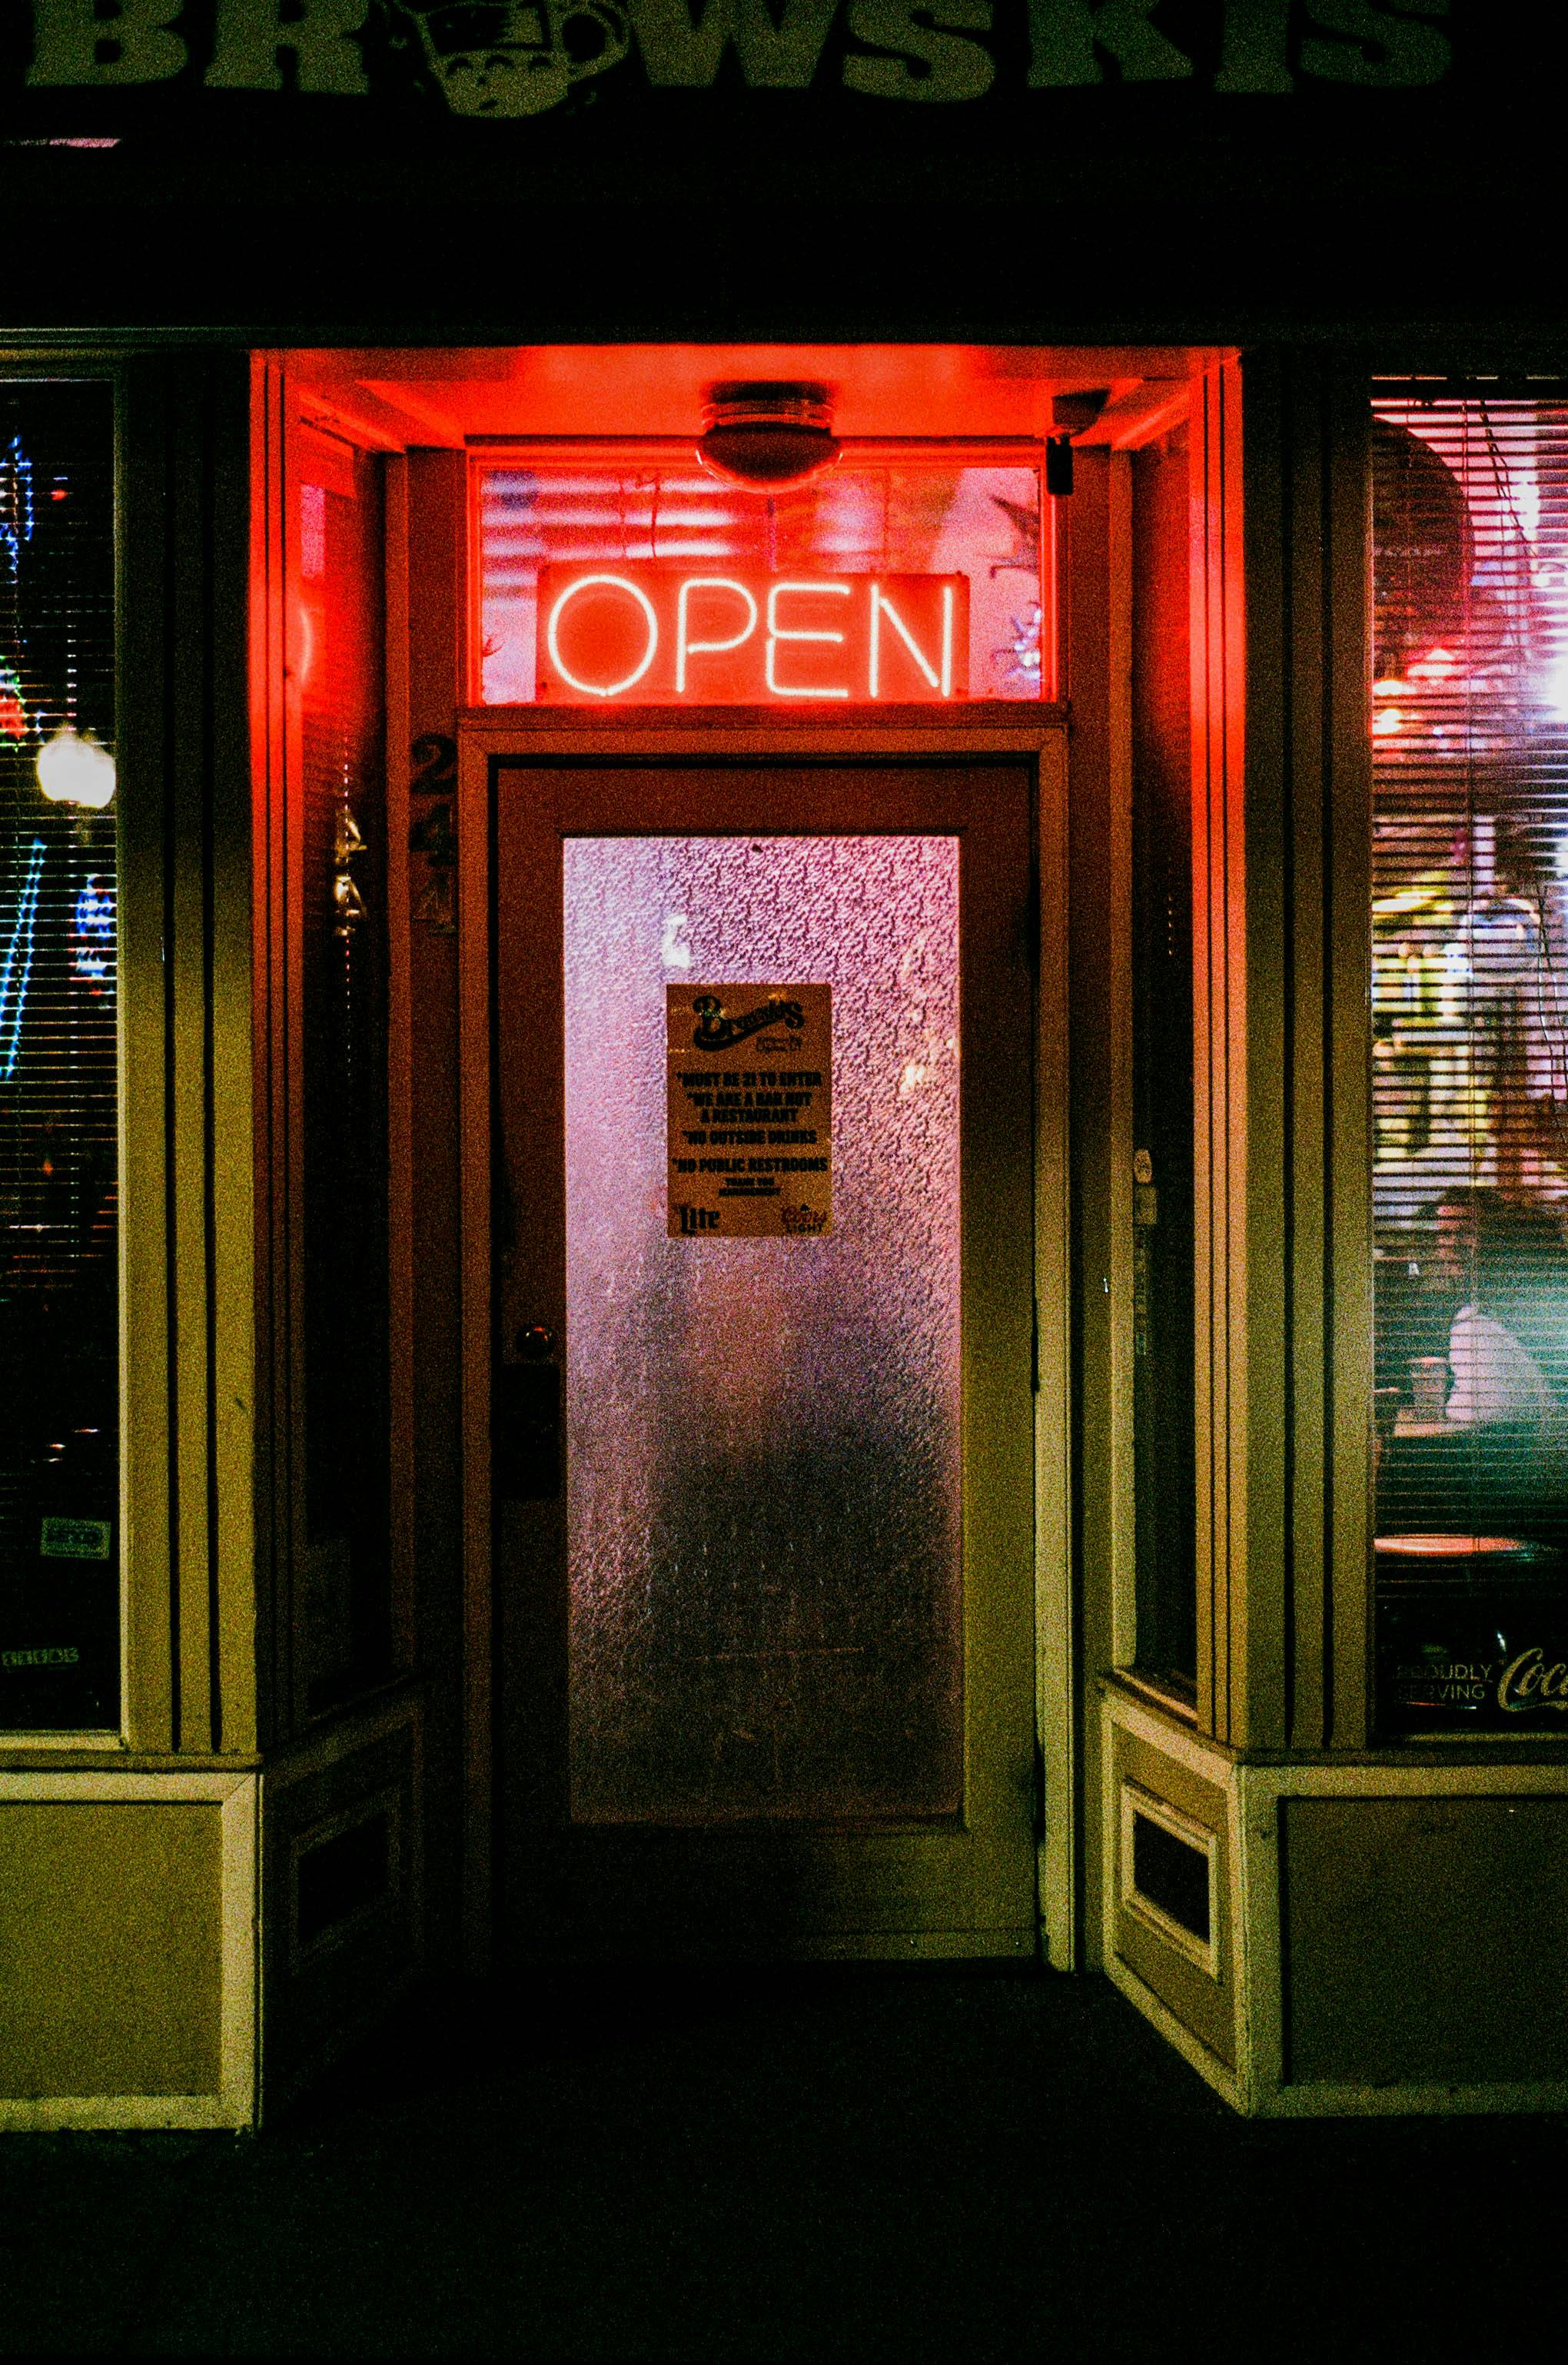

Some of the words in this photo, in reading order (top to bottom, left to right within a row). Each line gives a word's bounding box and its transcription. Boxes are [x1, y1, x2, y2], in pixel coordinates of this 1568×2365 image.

[548, 574, 953, 697] OPEN
[724, 1072, 739, 1086] BE
[743, 1072, 756, 1086] 21
[760, 1072, 775, 1086] TO
[780, 1072, 821, 1086] ENTER
[717, 1092, 741, 1106] ARE
[745, 1092, 752, 1106] A
[756, 1092, 782, 1106] BAR
[786, 1092, 812, 1106] NOT
[701, 1109, 709, 1122] A
[713, 1109, 799, 1122] RESTAURANT
[710, 1131, 765, 1144] OUTSIDE
[769, 1131, 816, 1144] DRINKS
[699, 1158, 745, 1171] PUBLIC
[749, 1158, 828, 1171] RESTROOMS
[676, 1204, 719, 1234] Lite
[781, 1205, 828, 1223] Coors
[786, 1223, 823, 1233] LIGHT
[1397, 1663, 1493, 1680] OUDLY
[1397, 1684, 1486, 1700] VING
